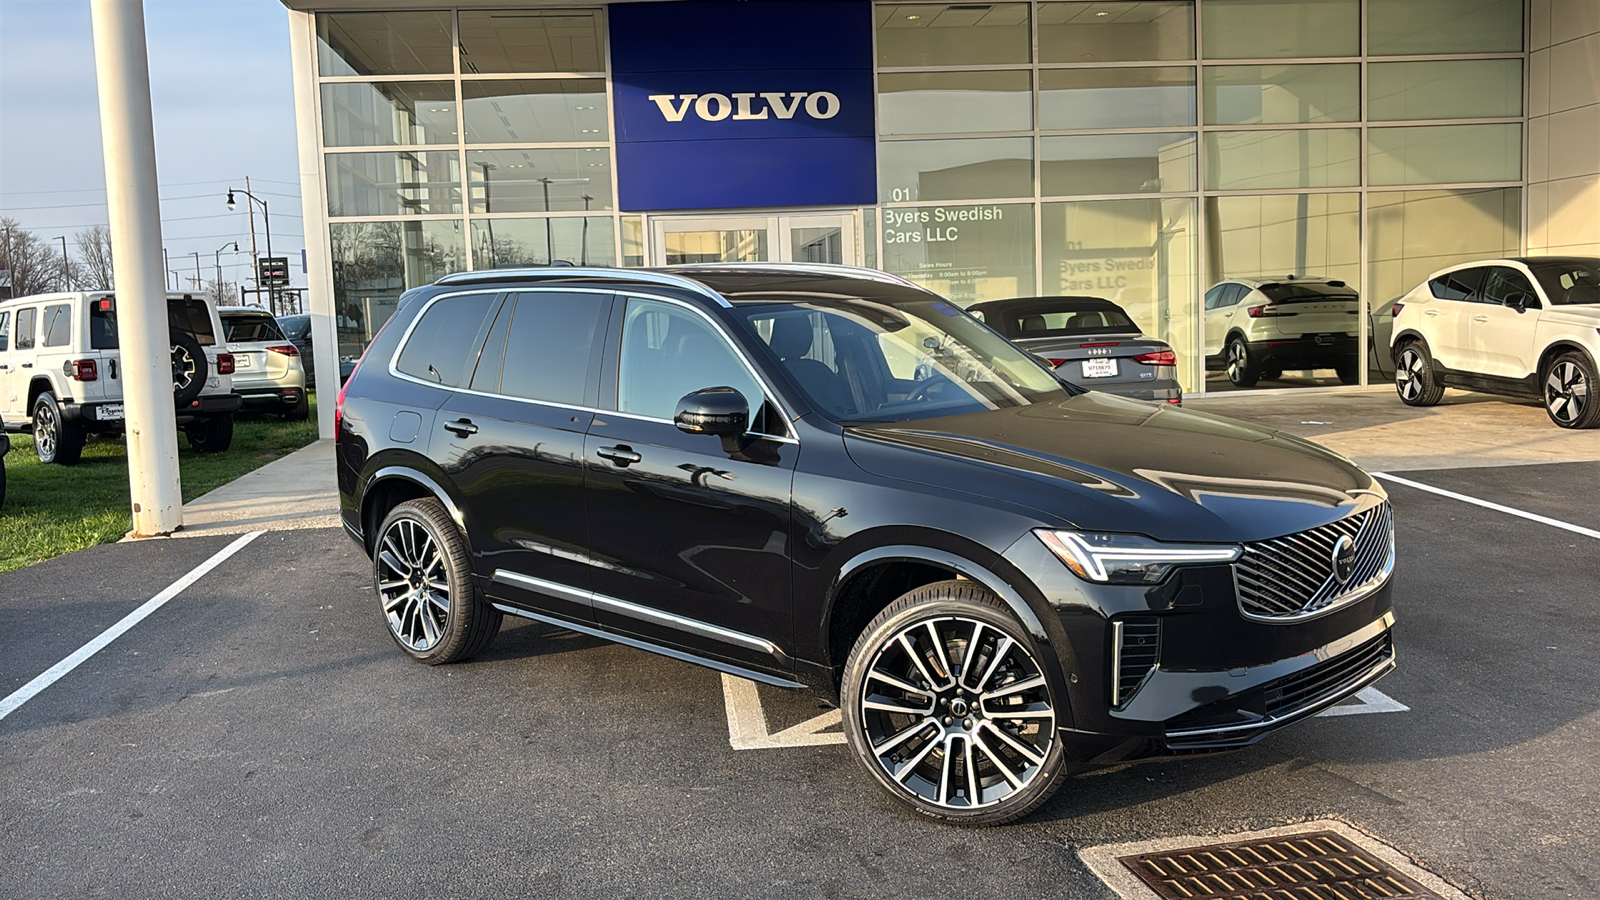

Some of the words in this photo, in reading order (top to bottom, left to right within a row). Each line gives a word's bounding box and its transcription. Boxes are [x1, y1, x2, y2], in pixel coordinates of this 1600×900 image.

[648, 91, 841, 122] VOLVO
[885, 210, 930, 227] Byers
[934, 206, 1003, 222] Swedish
[885, 229, 922, 244] Cars
[926, 227, 959, 242] LLC
[1105, 257, 1155, 271] Swedis
[1097, 276, 1127, 289] LLC
